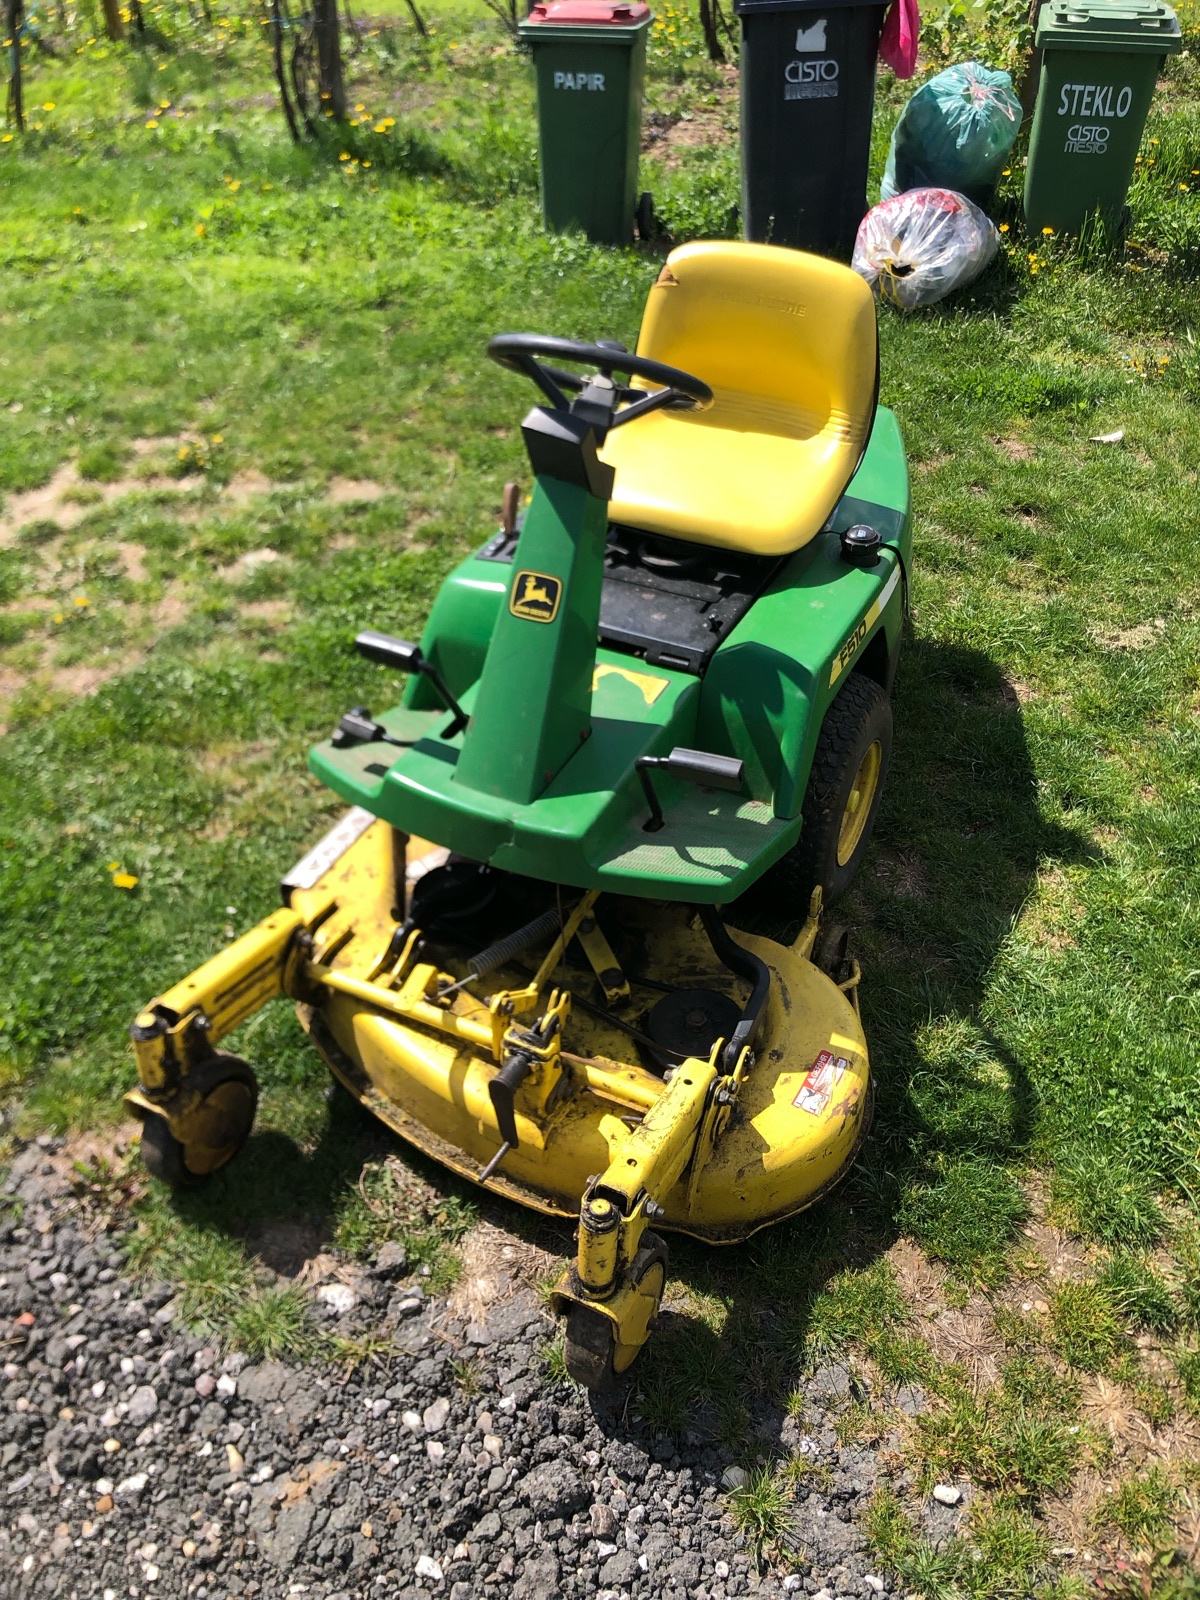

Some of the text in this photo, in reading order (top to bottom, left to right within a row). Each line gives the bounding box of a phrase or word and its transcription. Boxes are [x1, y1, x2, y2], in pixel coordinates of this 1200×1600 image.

[553, 71, 605, 91] PAPIR
[1057, 83, 1133, 118] STEKLO
[1063, 140, 1108, 154] MESTO
[839, 619, 868, 669] F510
